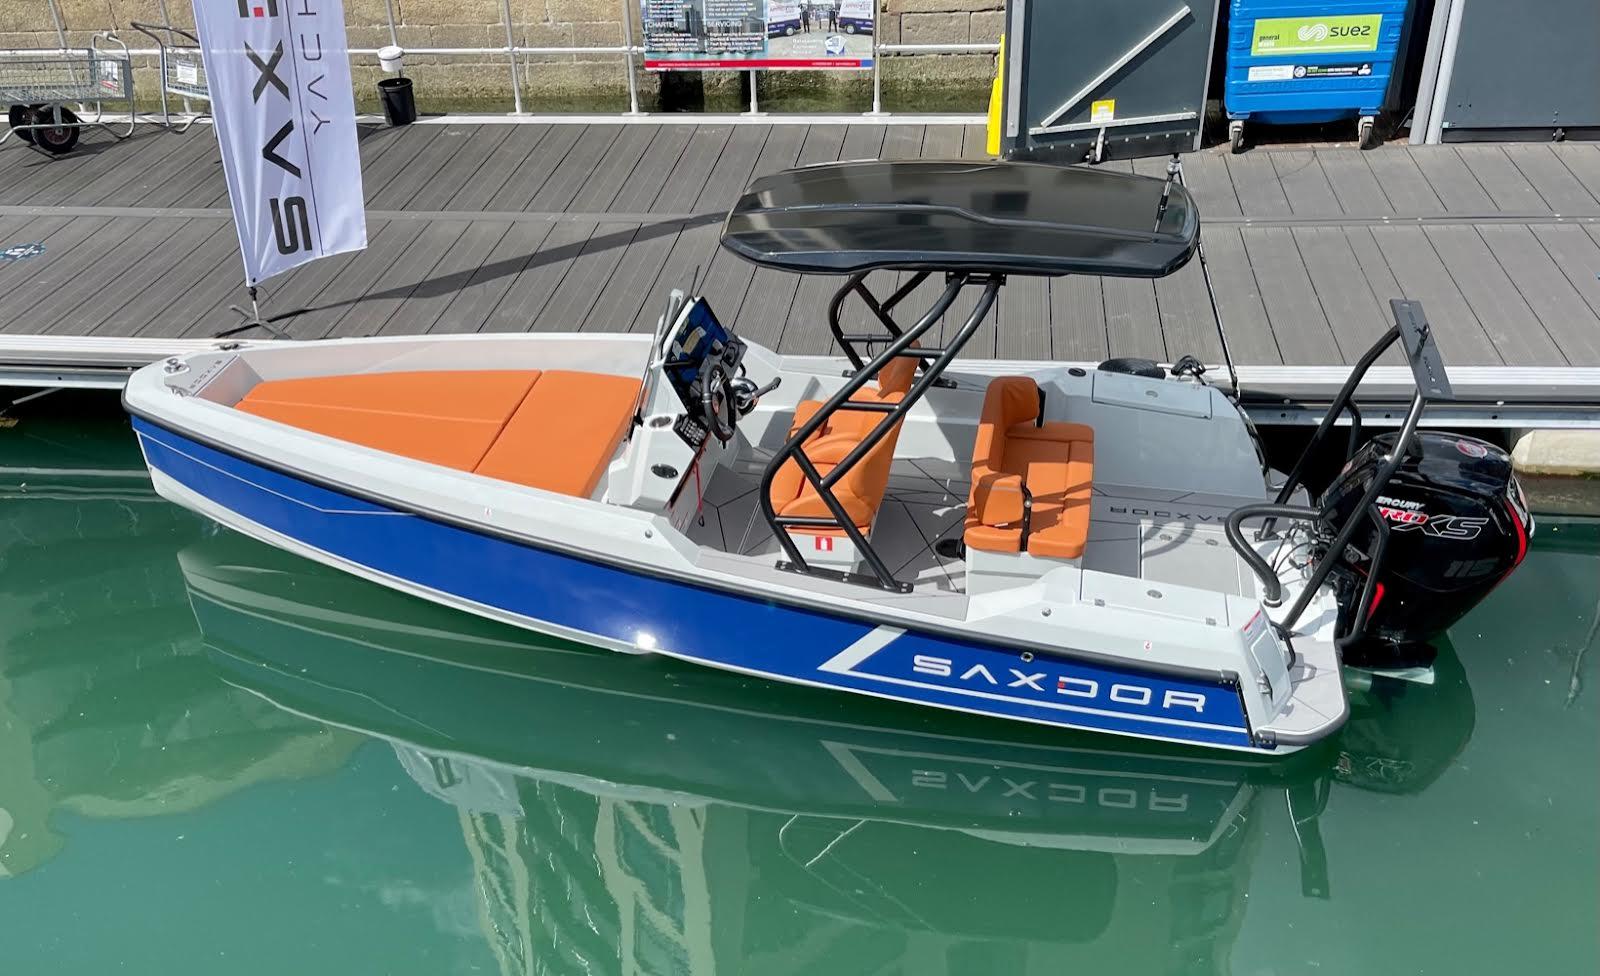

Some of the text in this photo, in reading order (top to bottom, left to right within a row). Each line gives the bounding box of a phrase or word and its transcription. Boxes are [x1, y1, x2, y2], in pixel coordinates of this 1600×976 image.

[1329, 25, 1371, 37] suez
[1375, 495, 1426, 510] ERCURY
[1443, 556, 1500, 578] 115
[912, 654, 1207, 713] SAXDOR
